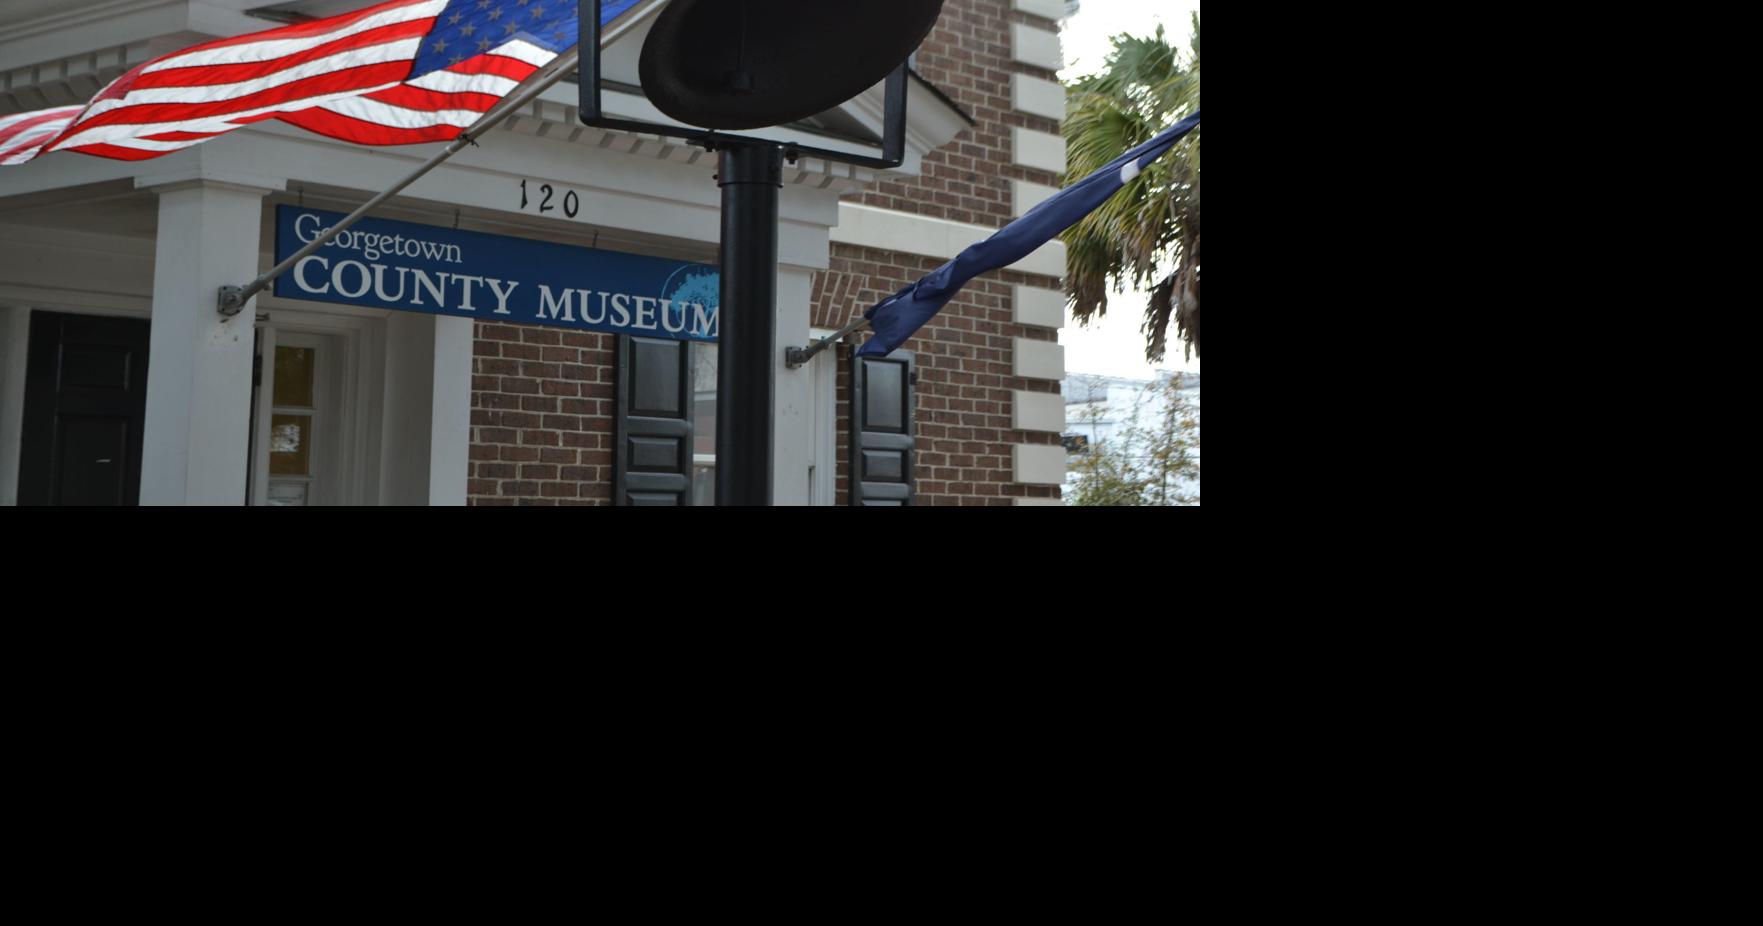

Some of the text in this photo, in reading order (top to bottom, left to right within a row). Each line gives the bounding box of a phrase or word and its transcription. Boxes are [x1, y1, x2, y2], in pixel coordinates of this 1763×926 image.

[520, 179, 579, 218] 120
[293, 255, 719, 337] COUNTY MUSEUM
